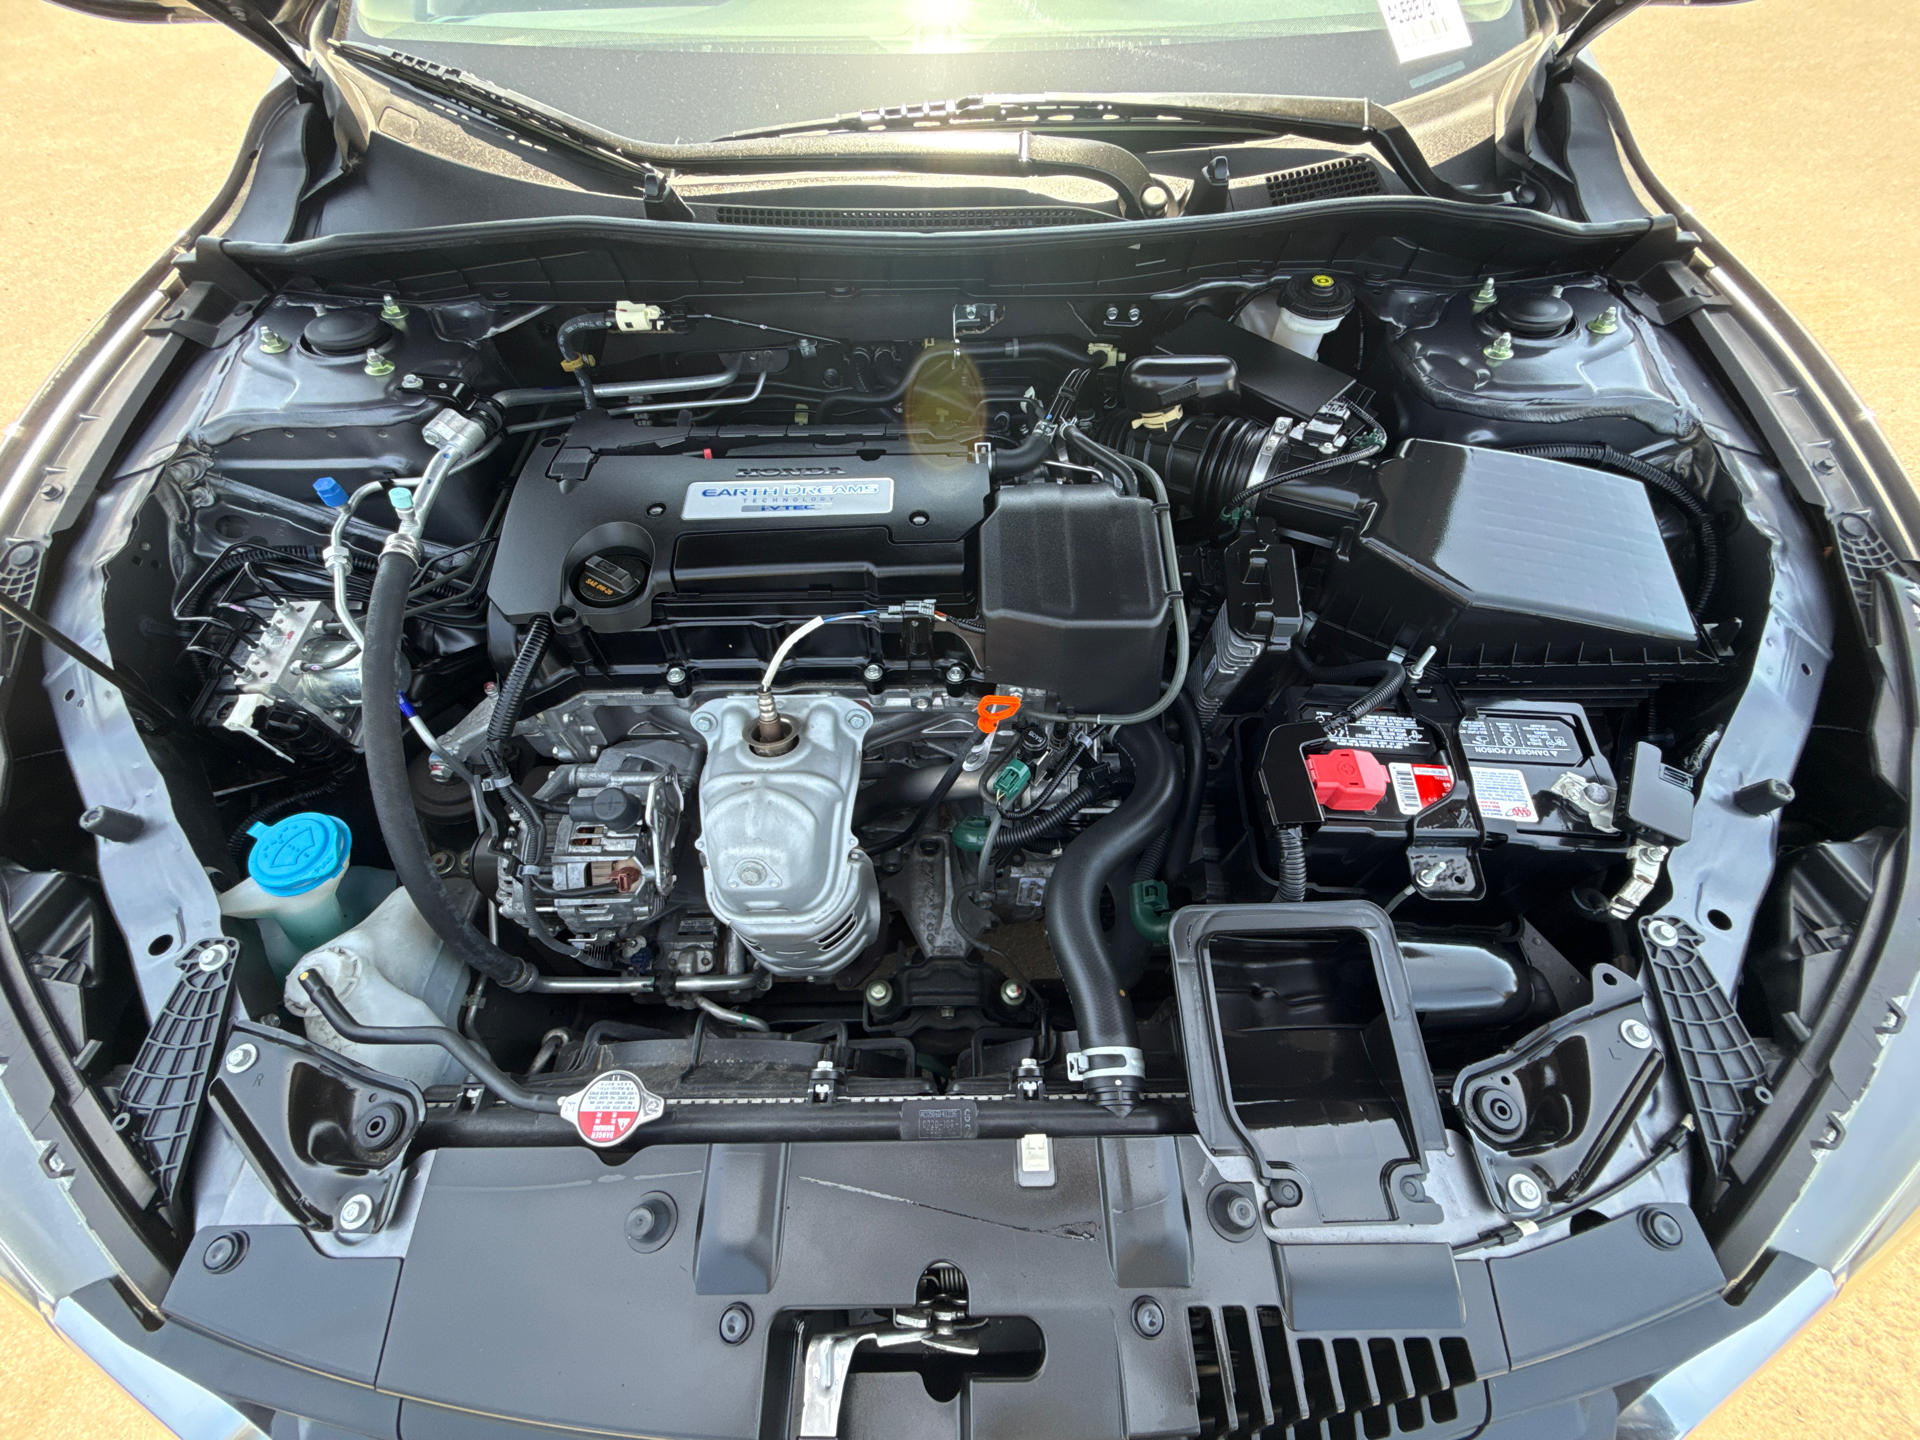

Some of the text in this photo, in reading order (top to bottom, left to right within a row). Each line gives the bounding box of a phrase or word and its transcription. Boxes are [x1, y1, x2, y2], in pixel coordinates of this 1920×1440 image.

[735, 466, 847, 477] HONDA
[701, 483, 880, 497] EARTH DREAMS
[743, 496, 835, 504] TECHNOLOGY
[585, 578, 598, 588] SAE
[596, 583, 614, 596] 0W-20
[1474, 746, 1506, 754] POISON
[1514, 748, 1550, 756] DANGER
[1512, 807, 1531, 817] AAA
[314, 857, 334, 873] PULL
[590, 1131, 614, 1139] DANGER
